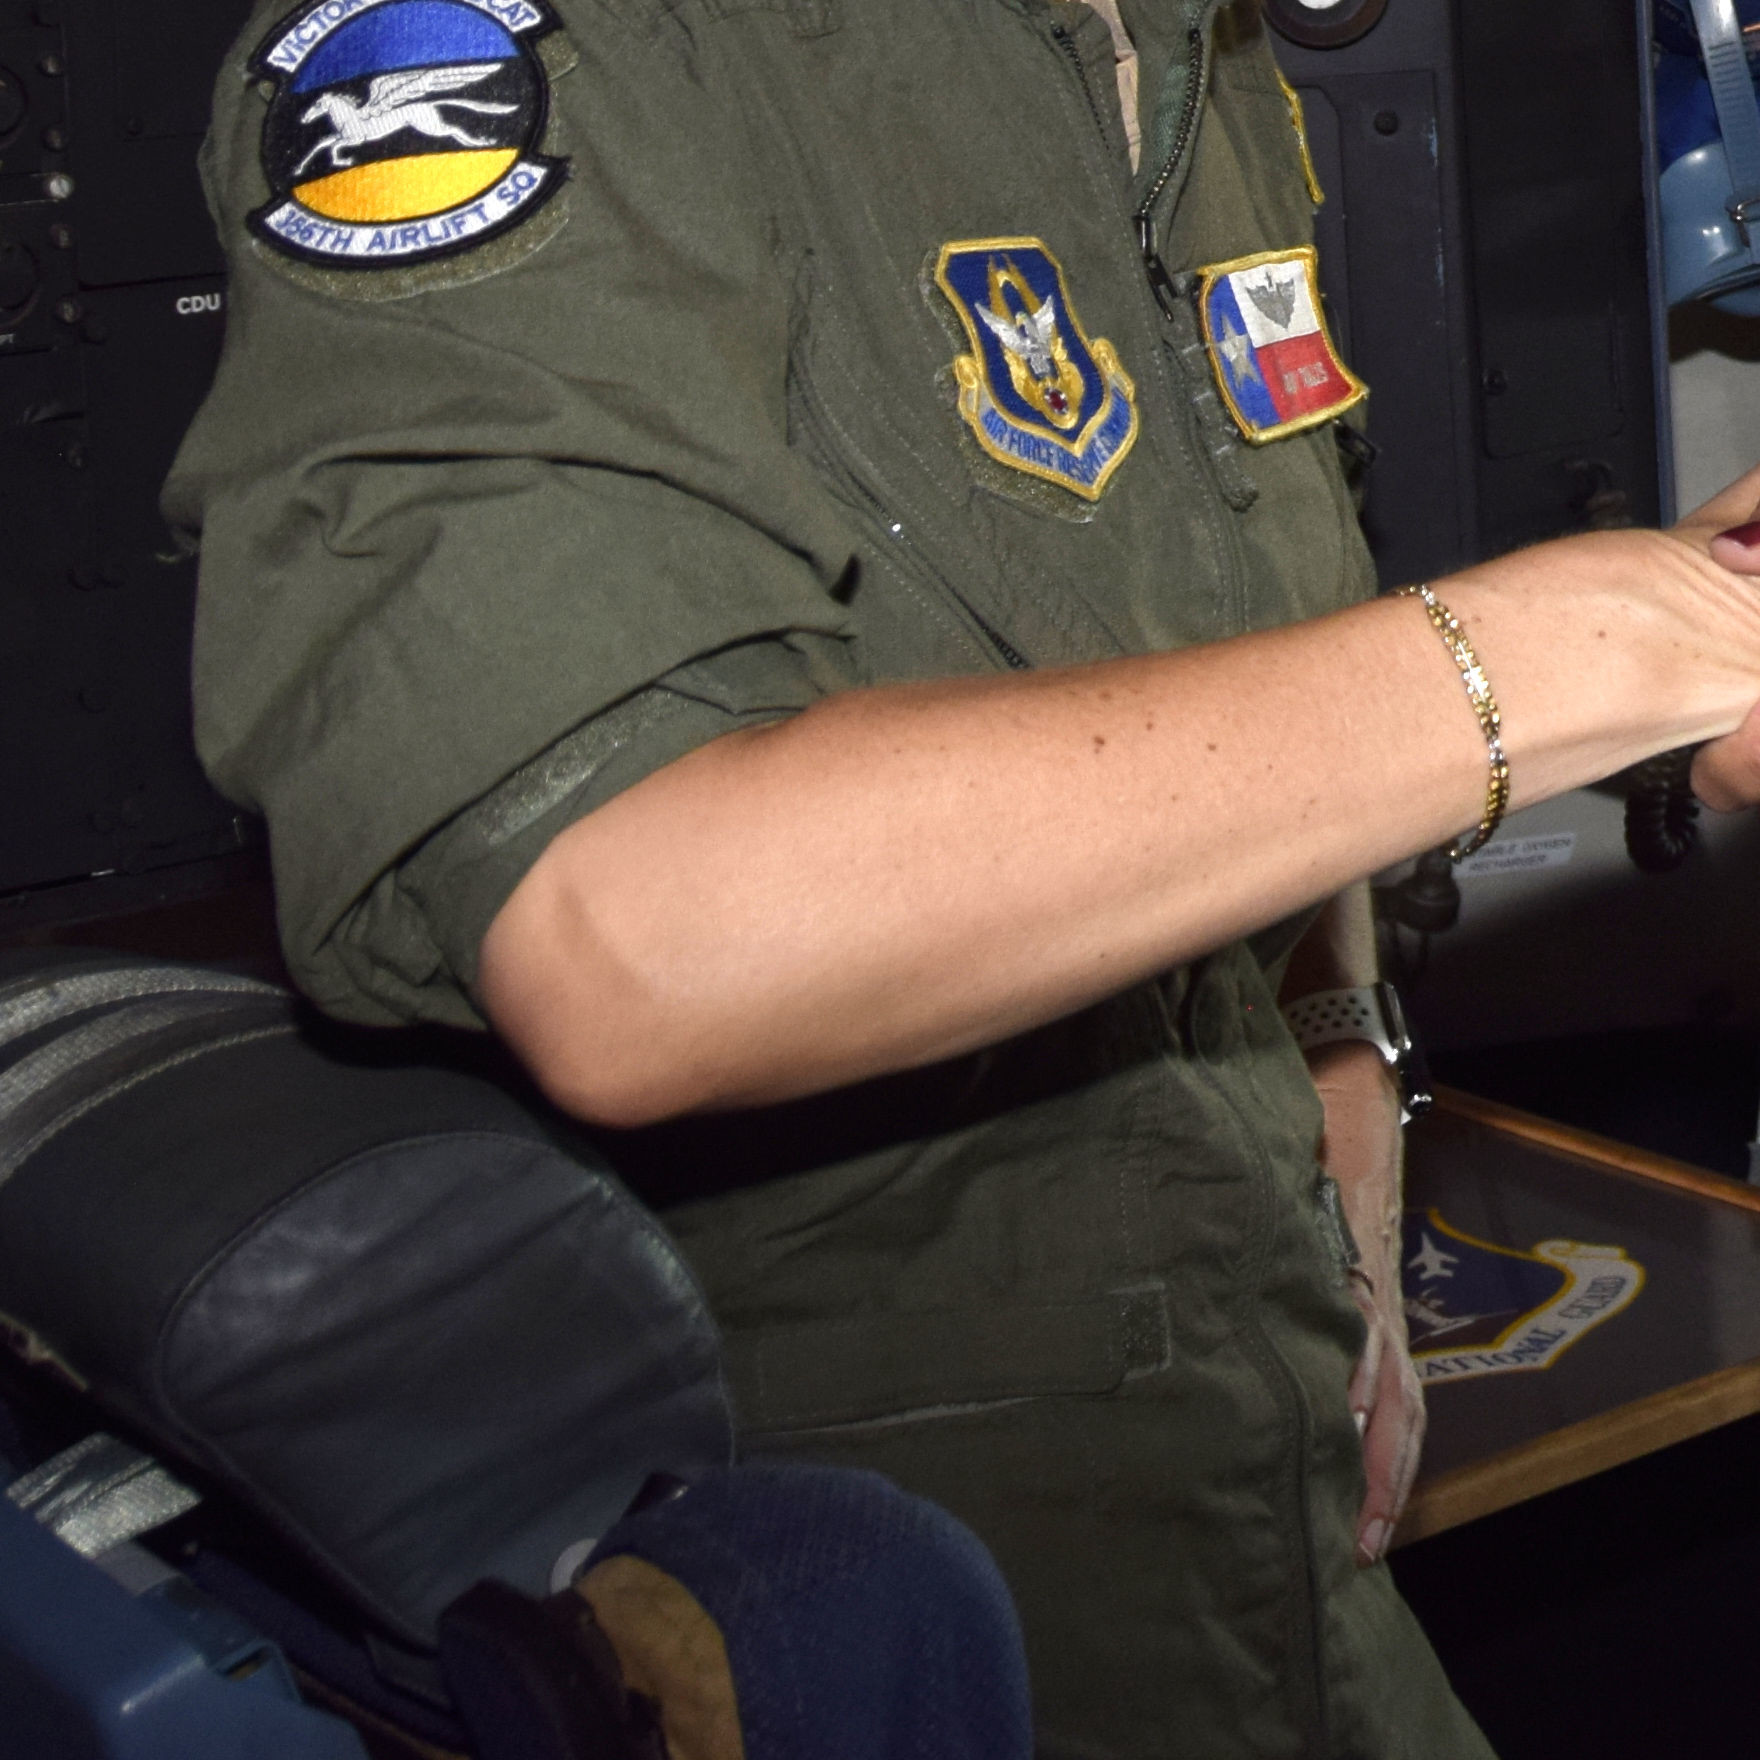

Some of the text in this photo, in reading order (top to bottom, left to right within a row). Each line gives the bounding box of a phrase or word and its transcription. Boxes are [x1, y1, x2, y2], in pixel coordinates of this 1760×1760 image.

[275, 170, 538, 253] 356TH AIRLIFT SQ
[175, 292, 222, 316] CDU
